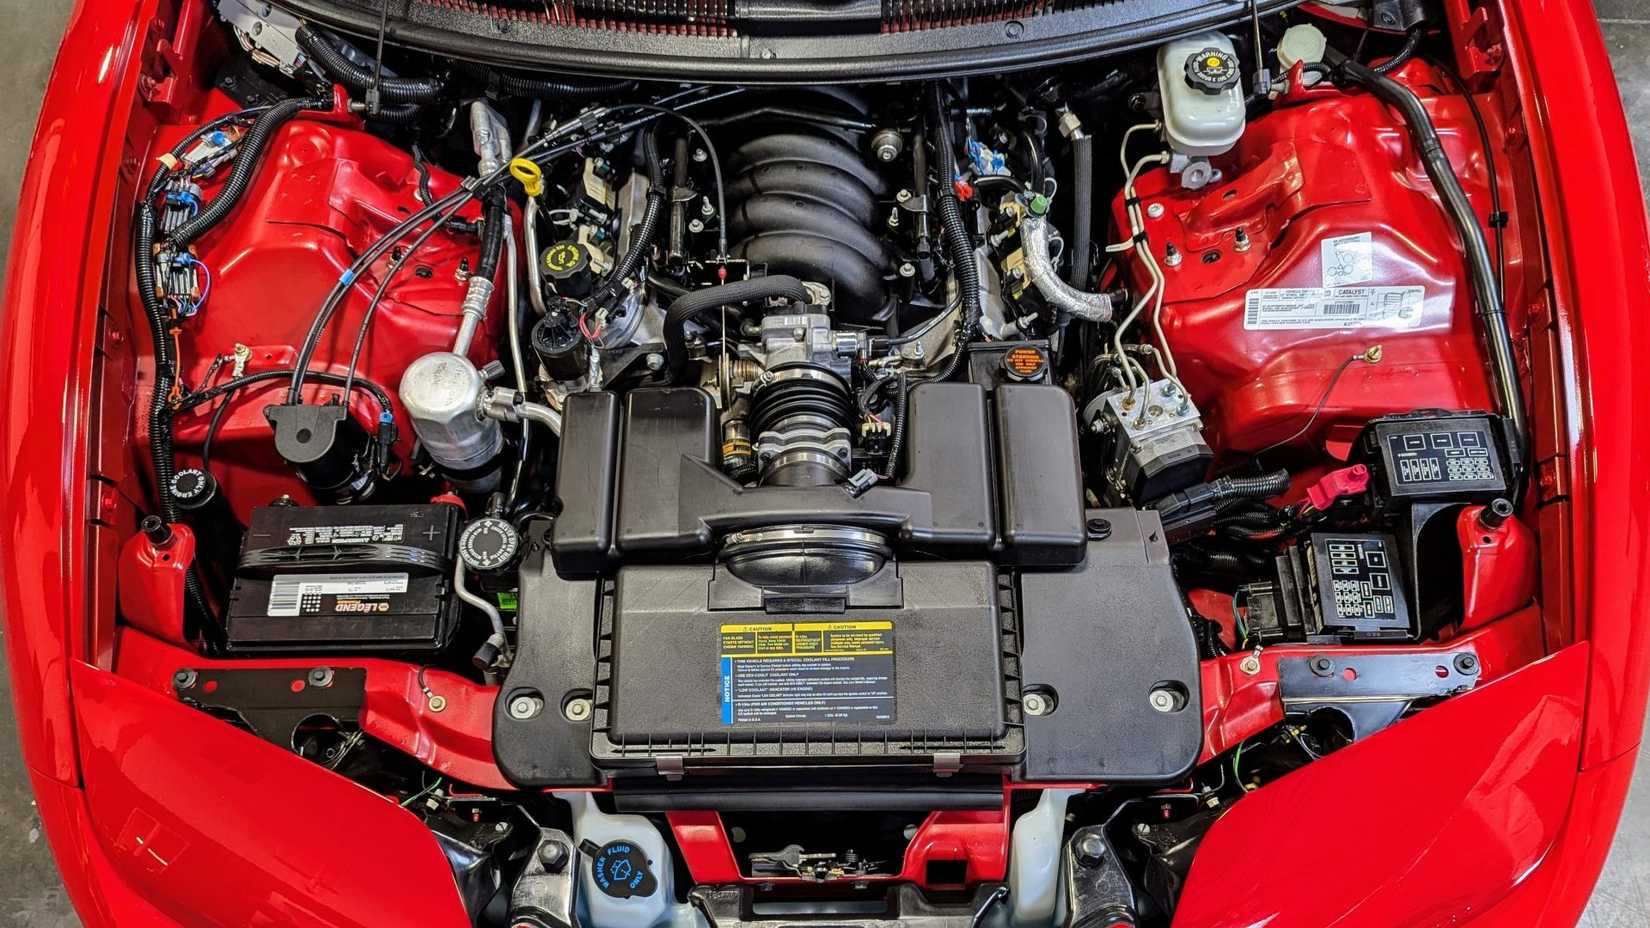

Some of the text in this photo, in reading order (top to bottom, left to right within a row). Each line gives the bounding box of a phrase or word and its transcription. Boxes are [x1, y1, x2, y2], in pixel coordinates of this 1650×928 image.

[1196, 51, 1229, 62] WARNING
[607, 845, 631, 856] FLUID
[630, 870, 644, 889] ONLY
